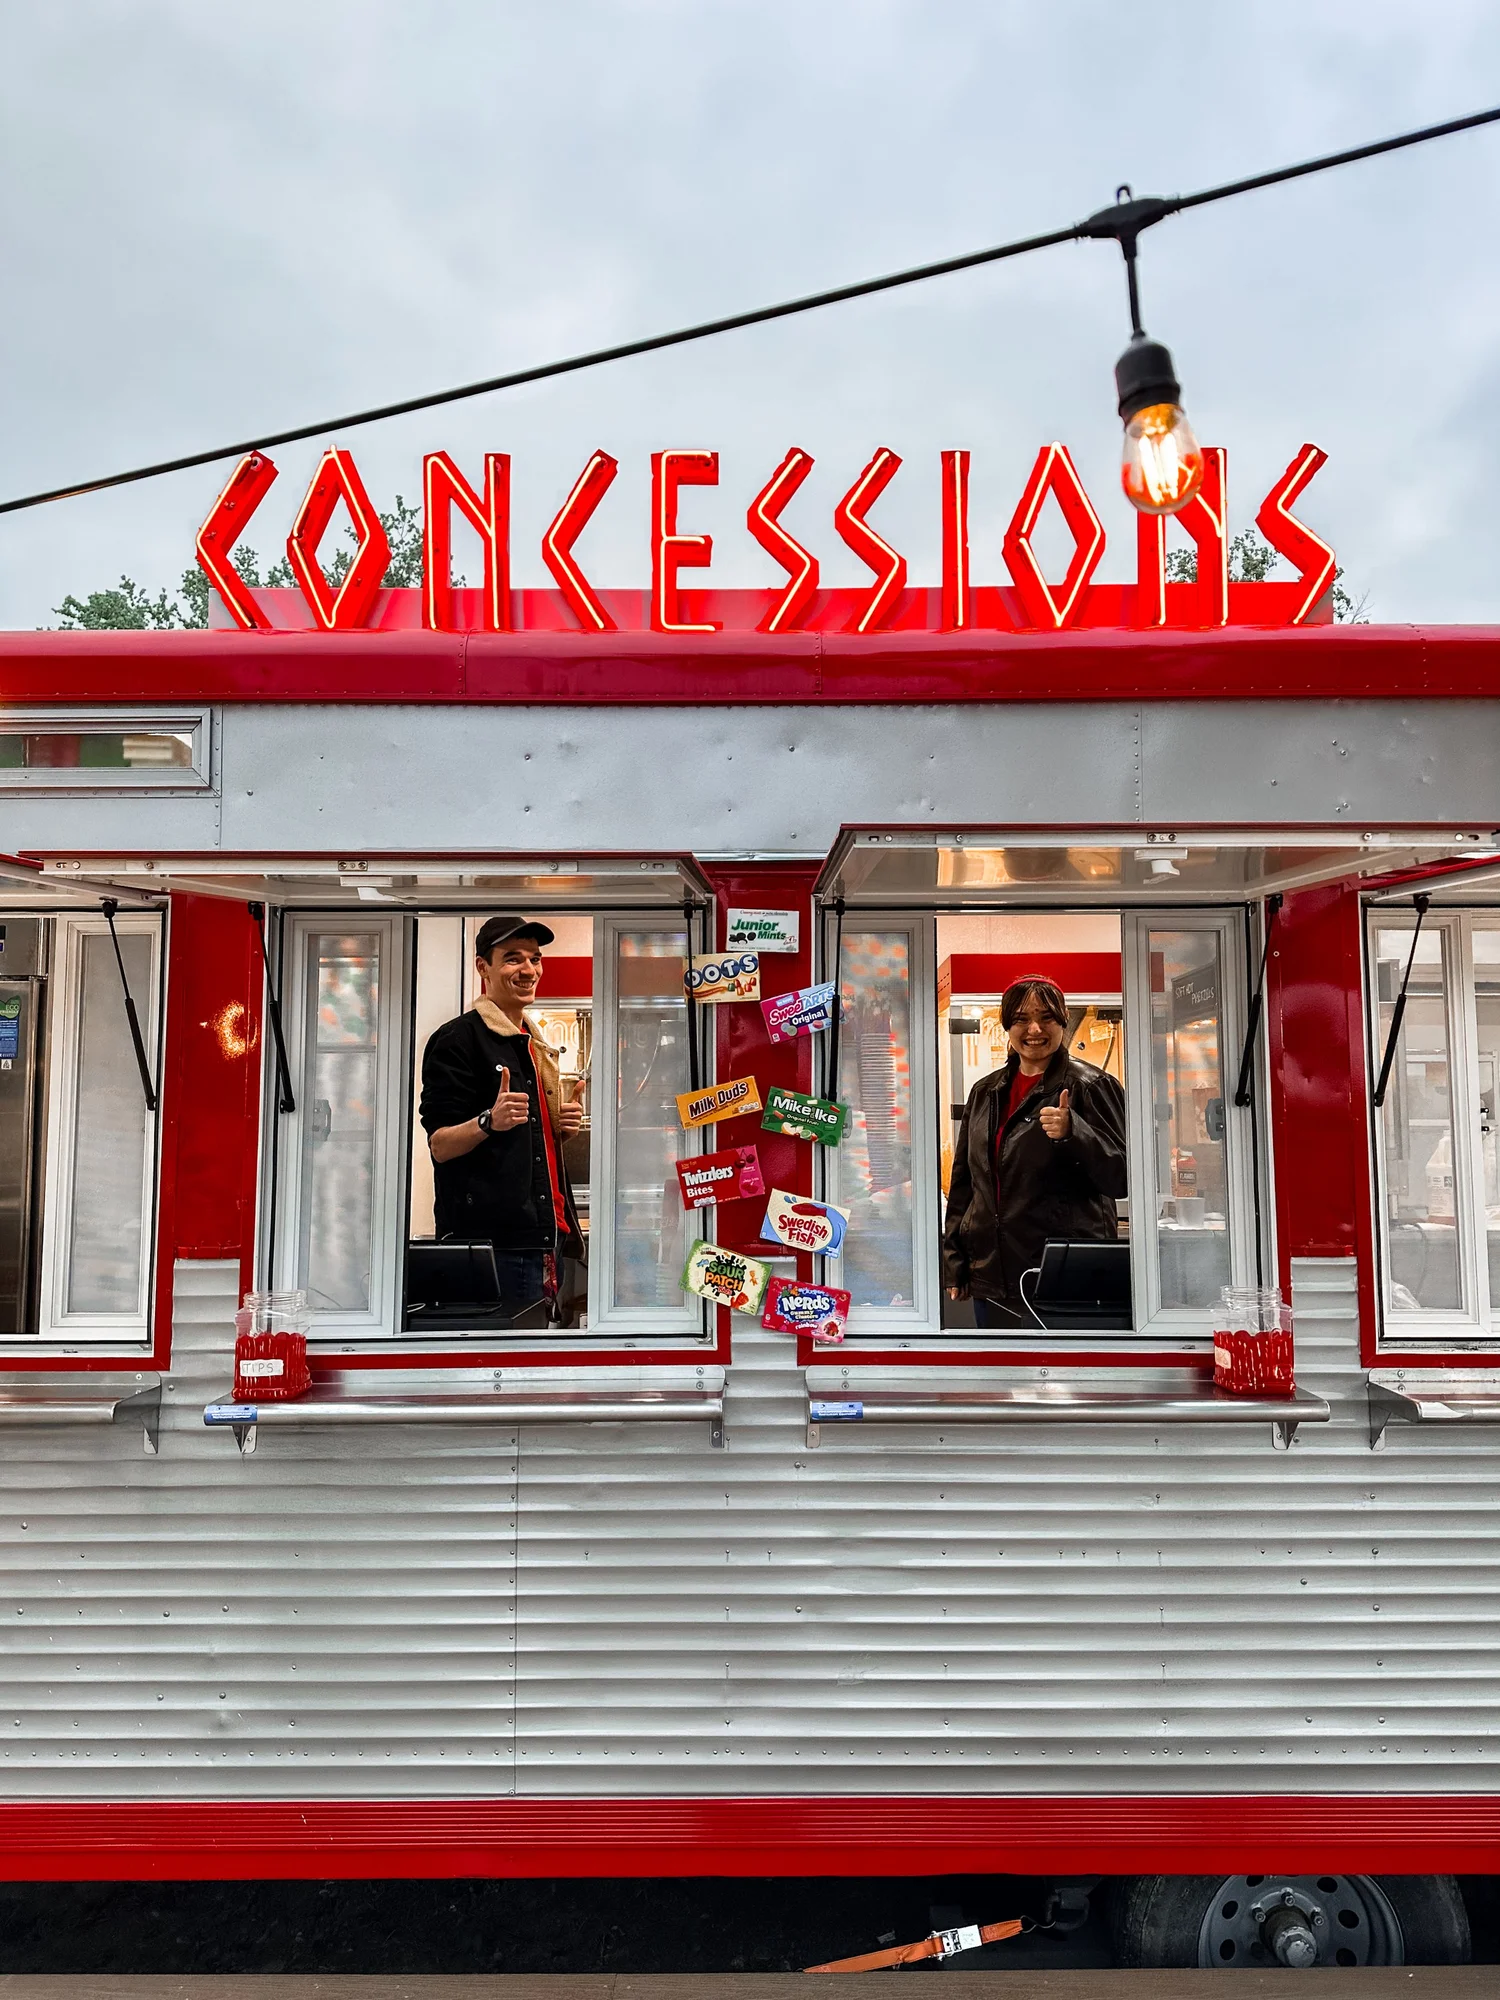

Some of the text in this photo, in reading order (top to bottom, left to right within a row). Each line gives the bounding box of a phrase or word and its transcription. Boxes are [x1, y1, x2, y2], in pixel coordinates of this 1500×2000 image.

[194, 443, 1336, 633] CONCESSIONS
[731, 919, 779, 931] Junior
[757, 931, 787, 940] Mints
[792, 1009, 824, 1026] Original
[688, 1096, 715, 1118] Milk
[716, 1082, 748, 1105] Duds
[773, 1096, 811, 1115] Mike
[815, 1108, 838, 1124] Ike
[681, 1166, 734, 1186] Twizzlers
[686, 1186, 714, 1198] Bites
[778, 1214, 828, 1238] Swedish
[788, 1228, 816, 1246] Fish
[709, 1261, 744, 1280] SOUR
[705, 1272, 743, 1291] PATCH
[242, 1362, 274, 1374] TIPS
